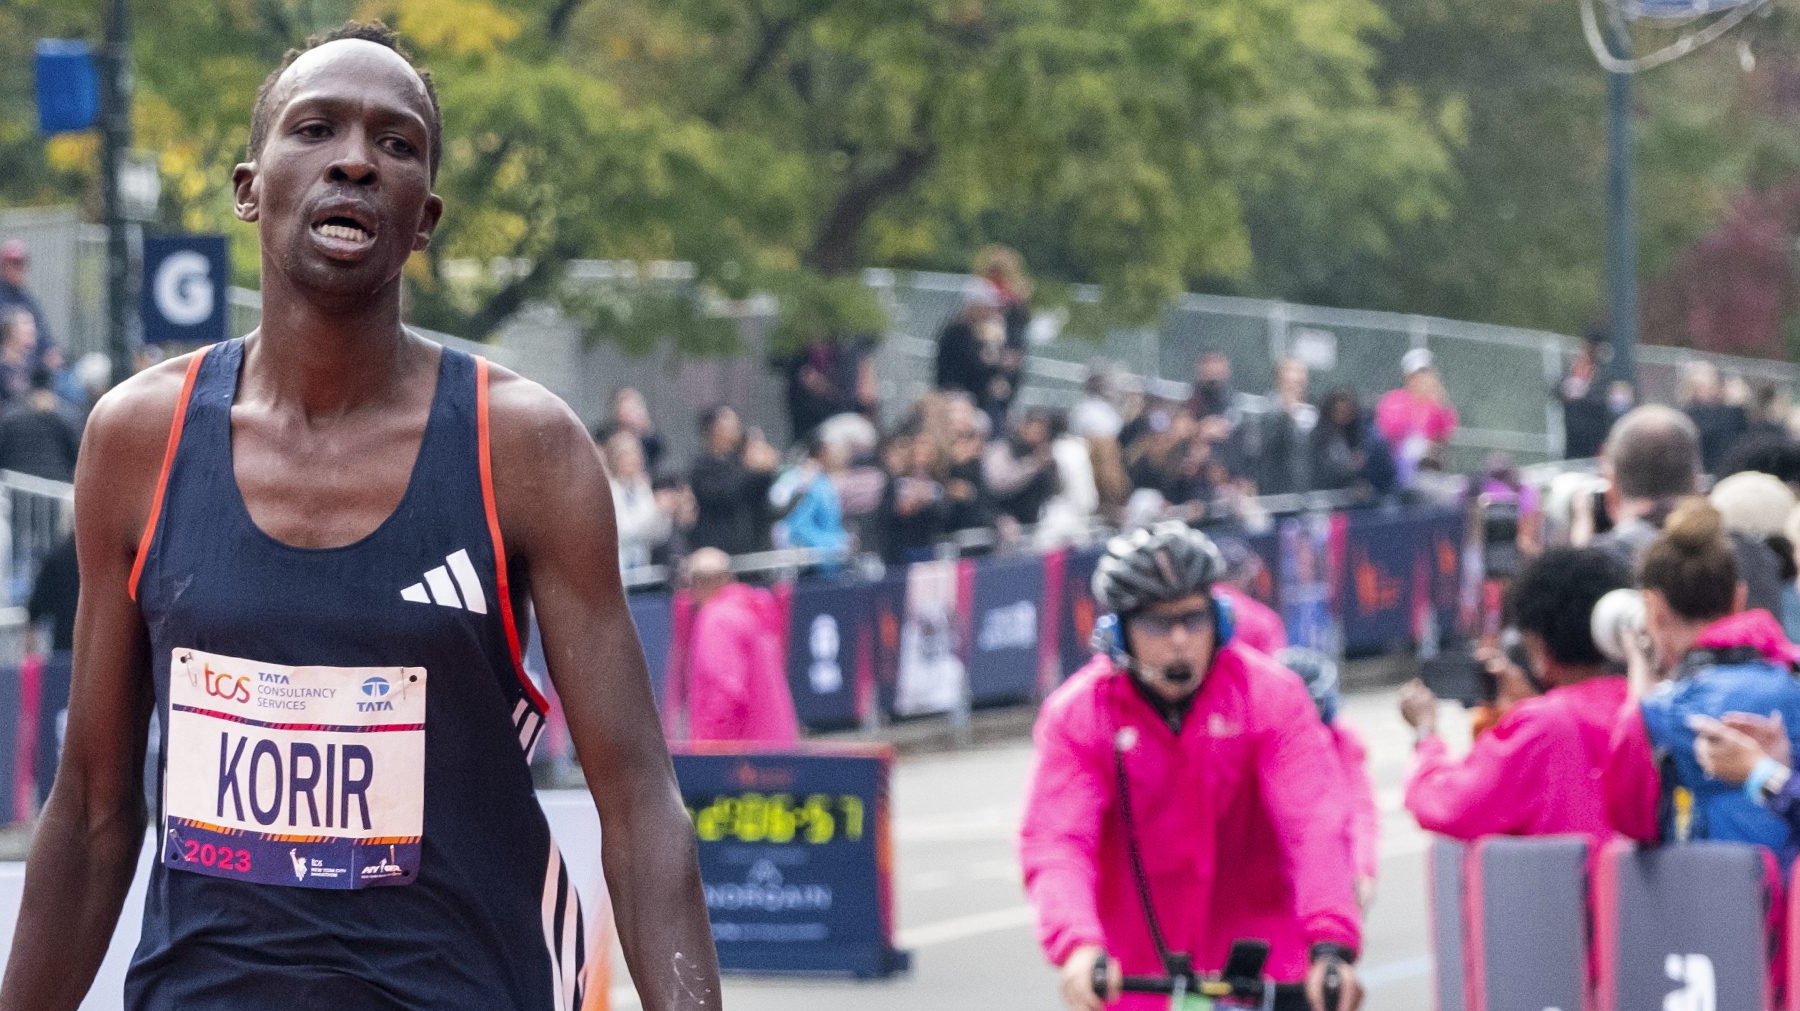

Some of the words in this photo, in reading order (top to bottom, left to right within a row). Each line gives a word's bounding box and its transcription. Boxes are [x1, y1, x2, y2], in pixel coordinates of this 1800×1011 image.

[153, 249, 215, 327] G
[204, 662, 250, 704] tcs
[258, 672, 289, 685] TATA
[257, 685, 336, 699] CONSULTANCY
[257, 697, 306, 711] SERVICES
[356, 701, 393, 713] TATA
[216, 731, 374, 830] KORIR
[184, 839, 251, 873] 2023
